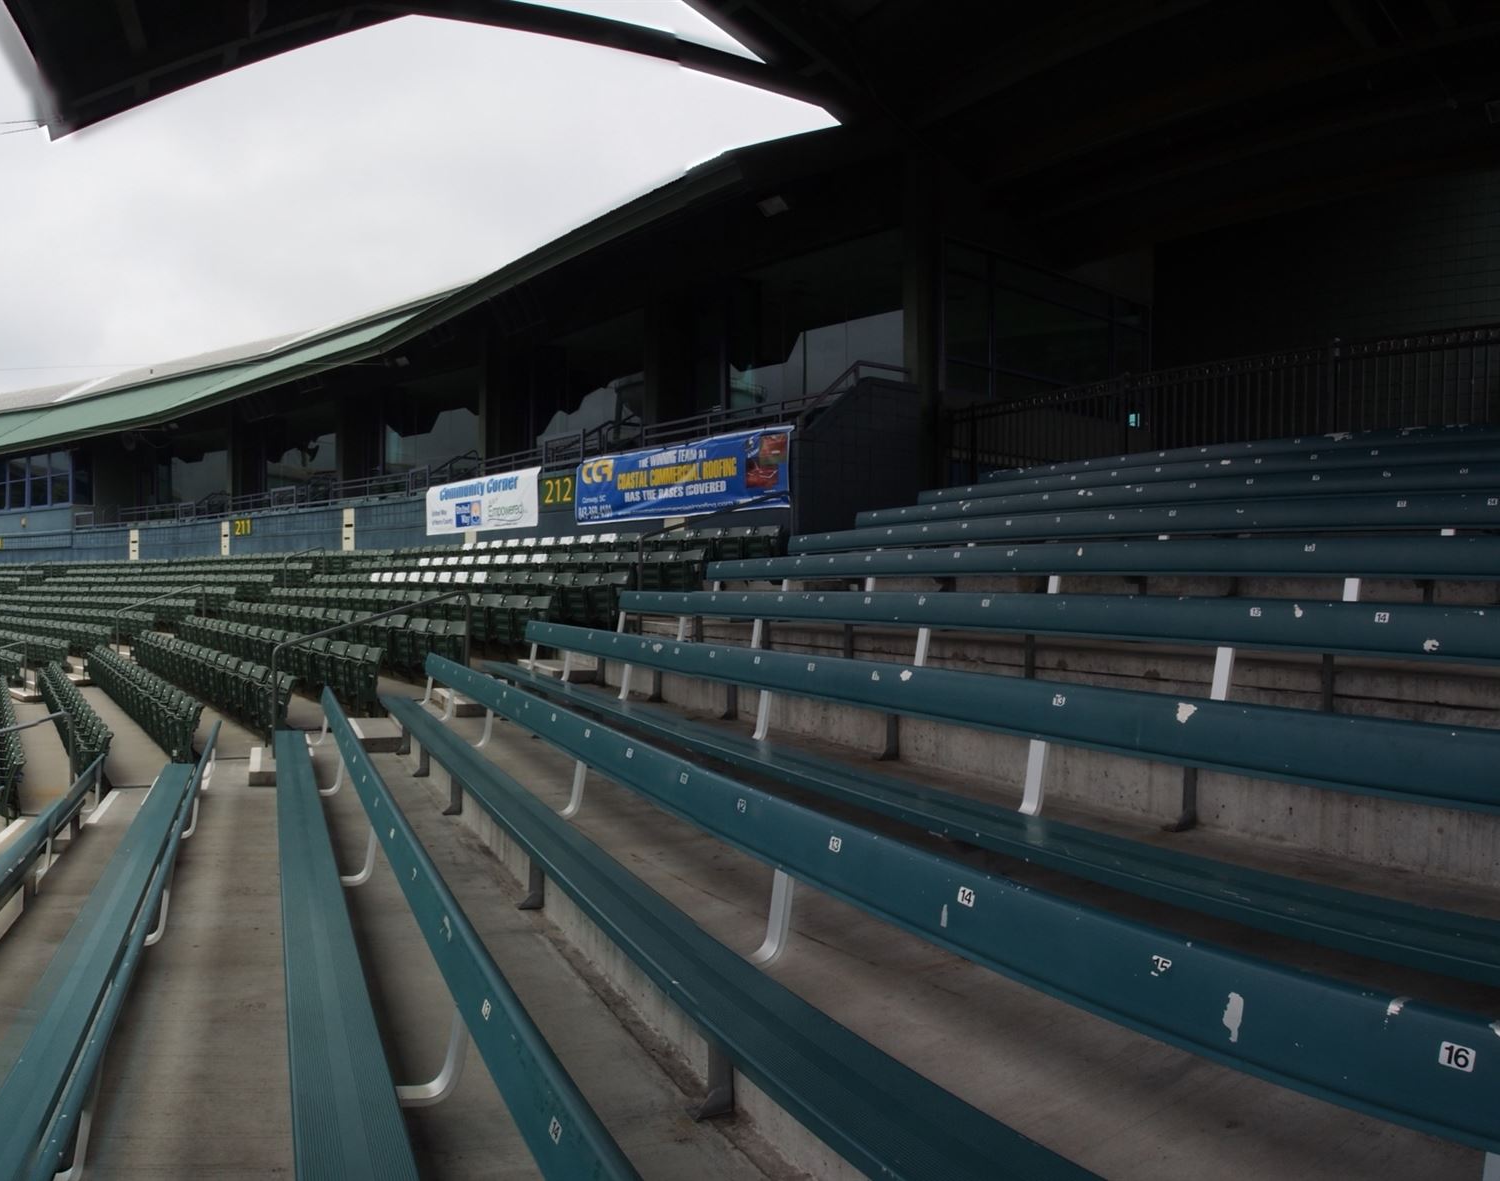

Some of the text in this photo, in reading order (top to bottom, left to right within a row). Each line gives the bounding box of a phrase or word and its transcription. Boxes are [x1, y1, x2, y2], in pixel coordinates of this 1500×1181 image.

[650, 450, 677, 467] WINNING
[678, 448, 697, 463] TEAM
[617, 457, 737, 490] COASTAL COMMERCIAL ROOFING
[440, 481, 485, 501] Community
[486, 476, 519, 494] Corner
[545, 477, 572, 504] 212
[624, 489, 641, 502] HAS
[642, 487, 657, 501] THE
[658, 485, 684, 500] BASES
[235, 520, 251, 535] 211
[1376, 612, 1388, 623] 14
[831, 837, 839, 851] 13
[960, 889, 972, 904] 14
[1445, 1045, 1470, 1068] 16
